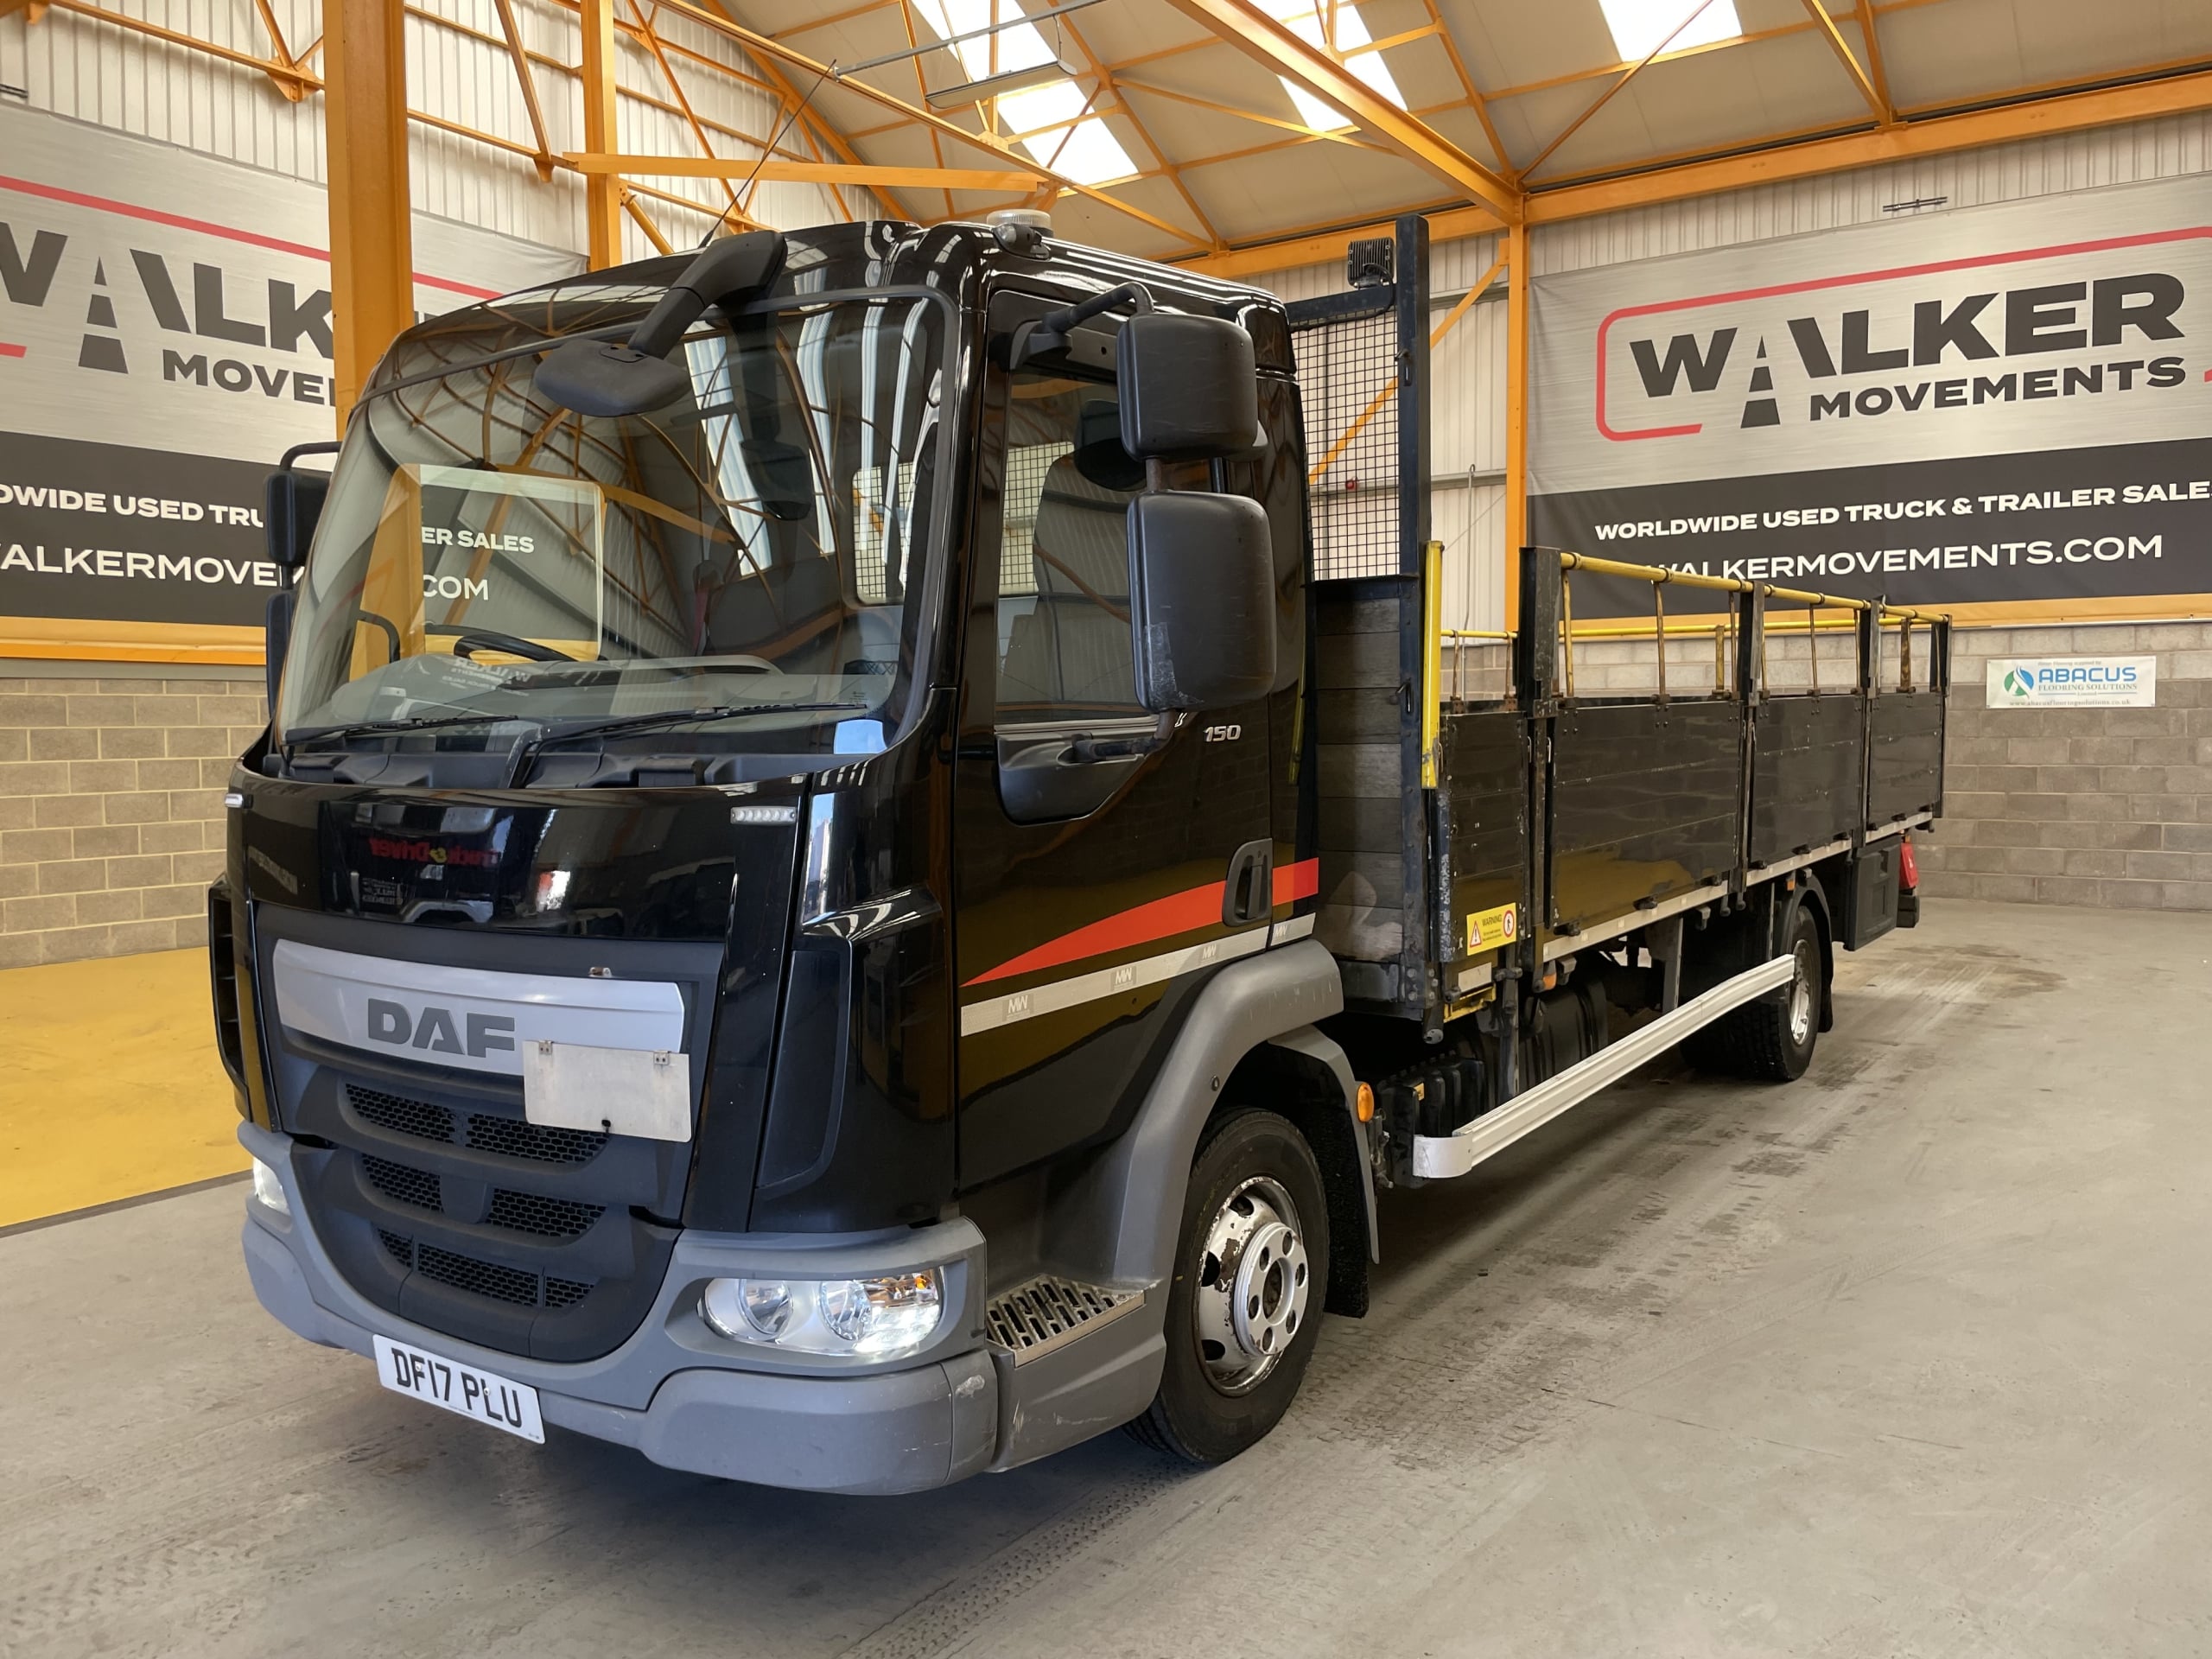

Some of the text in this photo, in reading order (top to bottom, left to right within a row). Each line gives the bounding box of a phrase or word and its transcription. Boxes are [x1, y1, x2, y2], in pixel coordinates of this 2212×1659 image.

[0, 222, 334, 375] WALK
[162, 349, 335, 406] MOVE
[1629, 273, 2185, 429] WALKER
[1810, 356, 2185, 422] MOVEMENTS
[113, 495, 204, 521] USED
[208, 504, 264, 528] TRU
[422, 527, 453, 545] ER
[457, 530, 534, 553] SALES
[1595, 481, 2212, 540] WORLDWIDE USED TRUCK & TRAILER SALE
[0, 543, 489, 601] ALKERMOVE COM
[2038, 667, 2137, 683] ABACUS
[1204, 724, 1241, 742] 150
[1482, 914, 1503, 926] WARNING
[368, 998, 515, 1058] DAF
[1008, 995, 1028, 1014] MW
[391, 1347, 523, 1428] DF17 PLU
